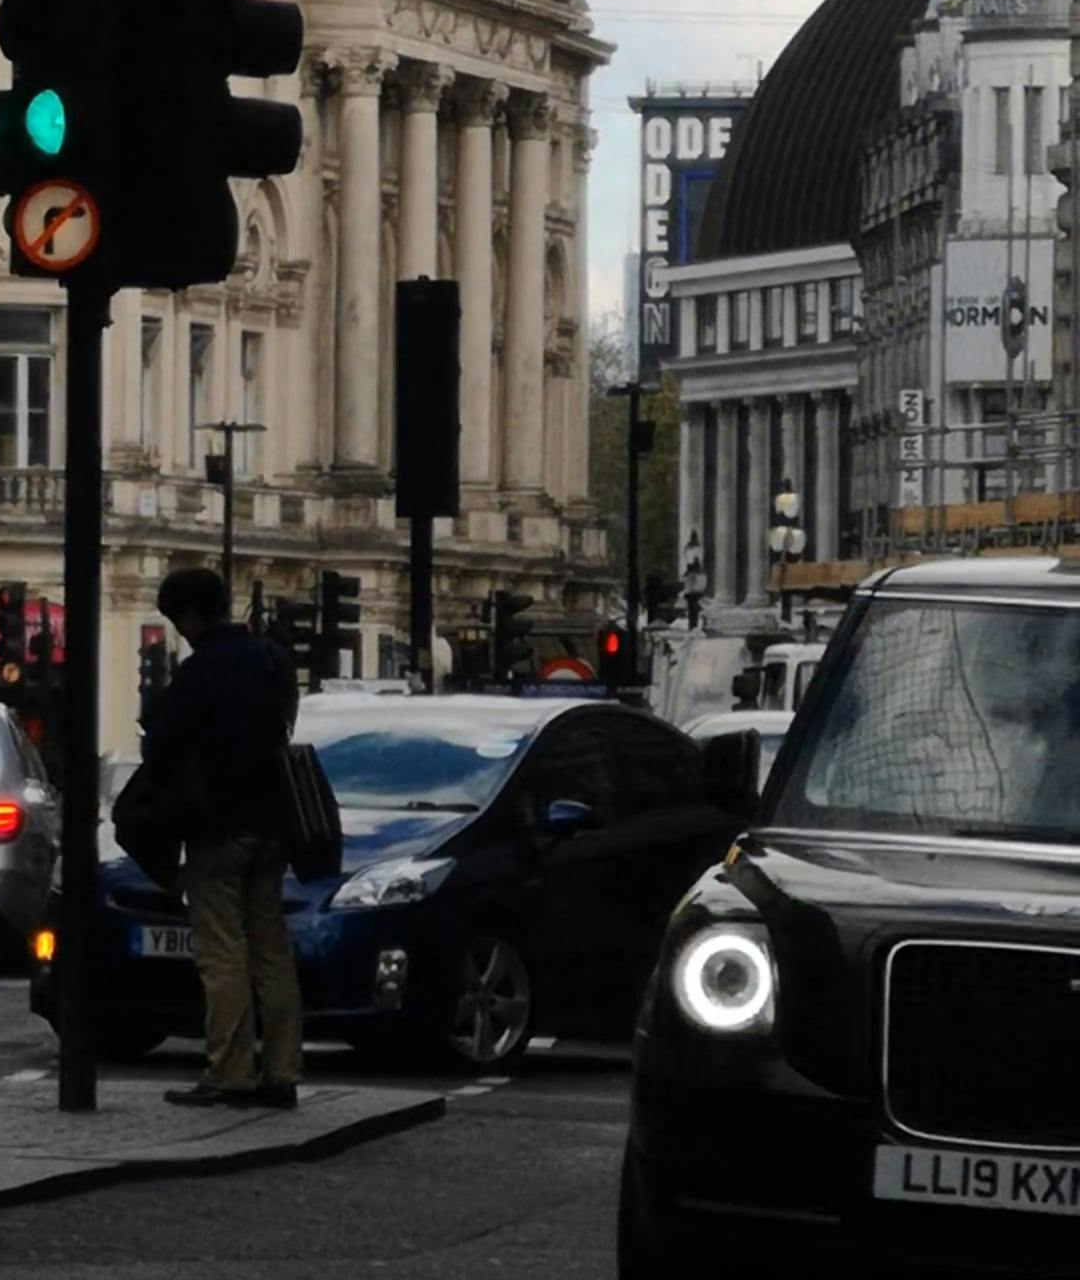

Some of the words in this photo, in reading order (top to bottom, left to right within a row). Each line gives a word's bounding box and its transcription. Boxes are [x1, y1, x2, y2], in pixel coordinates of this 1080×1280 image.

[646, 117, 732, 161] ODE
[944, 306, 1048, 327] ORMN
[904, 393, 919, 483] MORON
[903, 1153, 999, 1199] LL19
